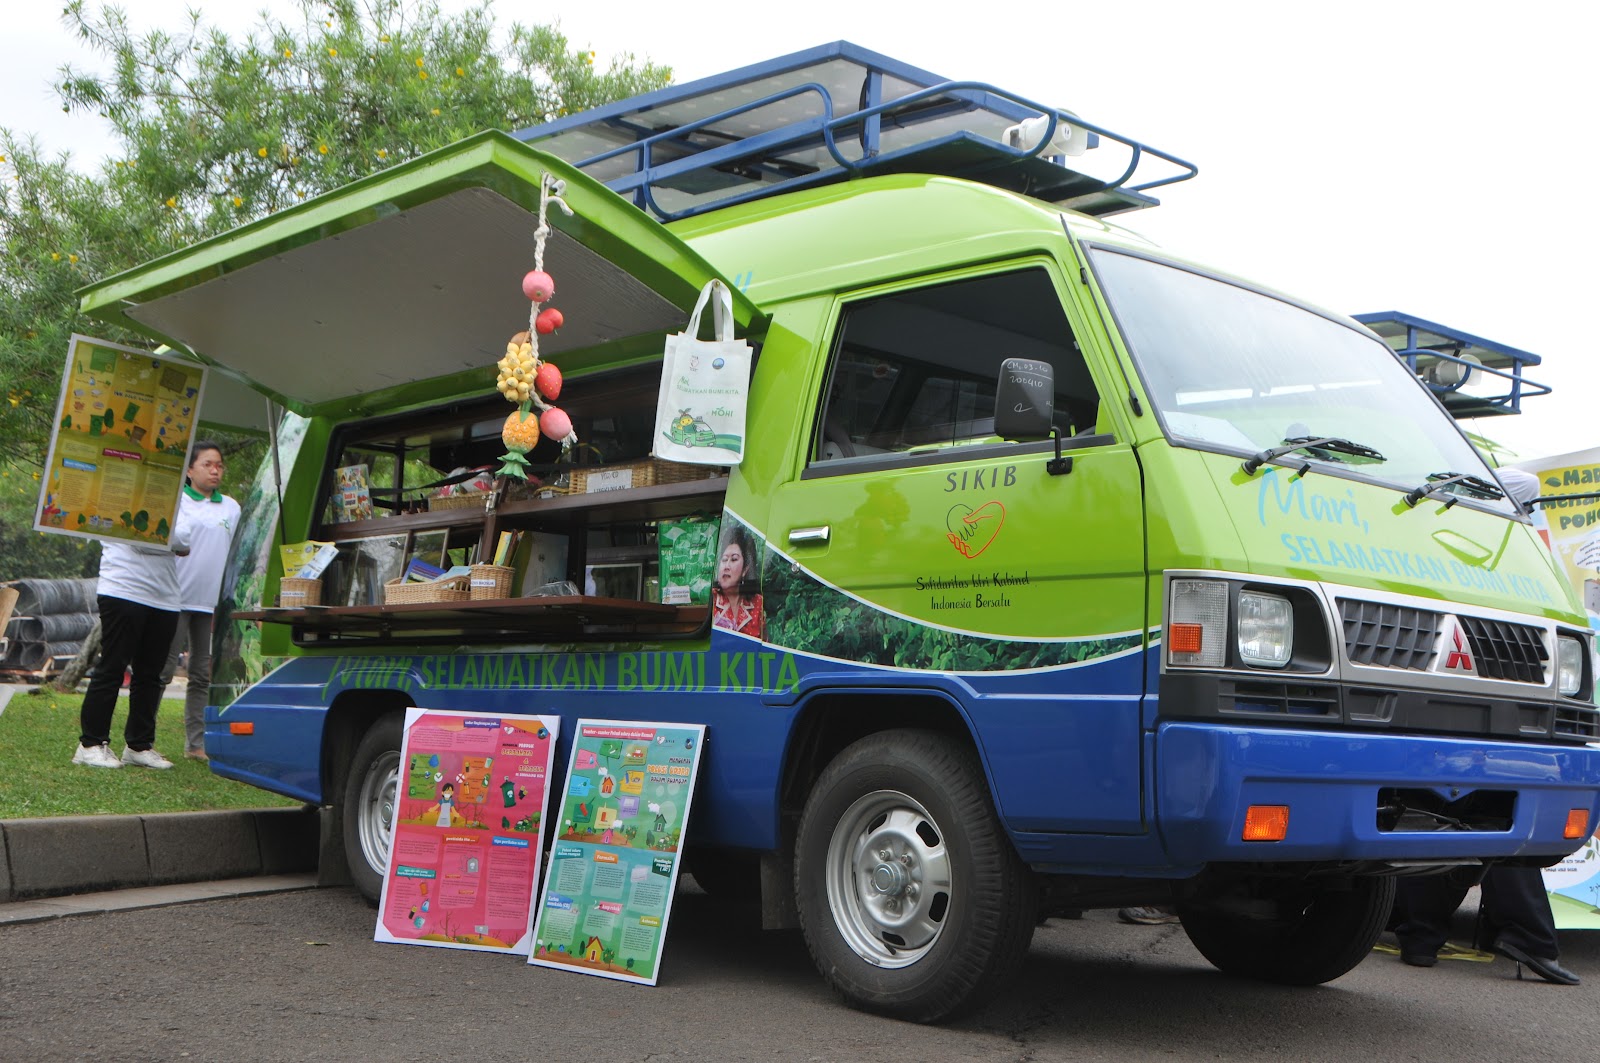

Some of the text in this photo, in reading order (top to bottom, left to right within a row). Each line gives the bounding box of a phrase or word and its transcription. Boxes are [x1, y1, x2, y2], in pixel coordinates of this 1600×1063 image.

[944, 465, 1017, 492] SIKIB
[1258, 468, 1370, 535] Mari,
[916, 571, 1030, 590] Solidaritas Istri Kabinet
[1280, 532, 1552, 602] SELAMATKAN BUMI KITA
[931, 593, 1011, 610] Indonesia Bersatu
[420, 653, 605, 691] SELAMATKAN
[618, 652, 706, 692] BUMI
[720, 652, 800, 694] KITA
